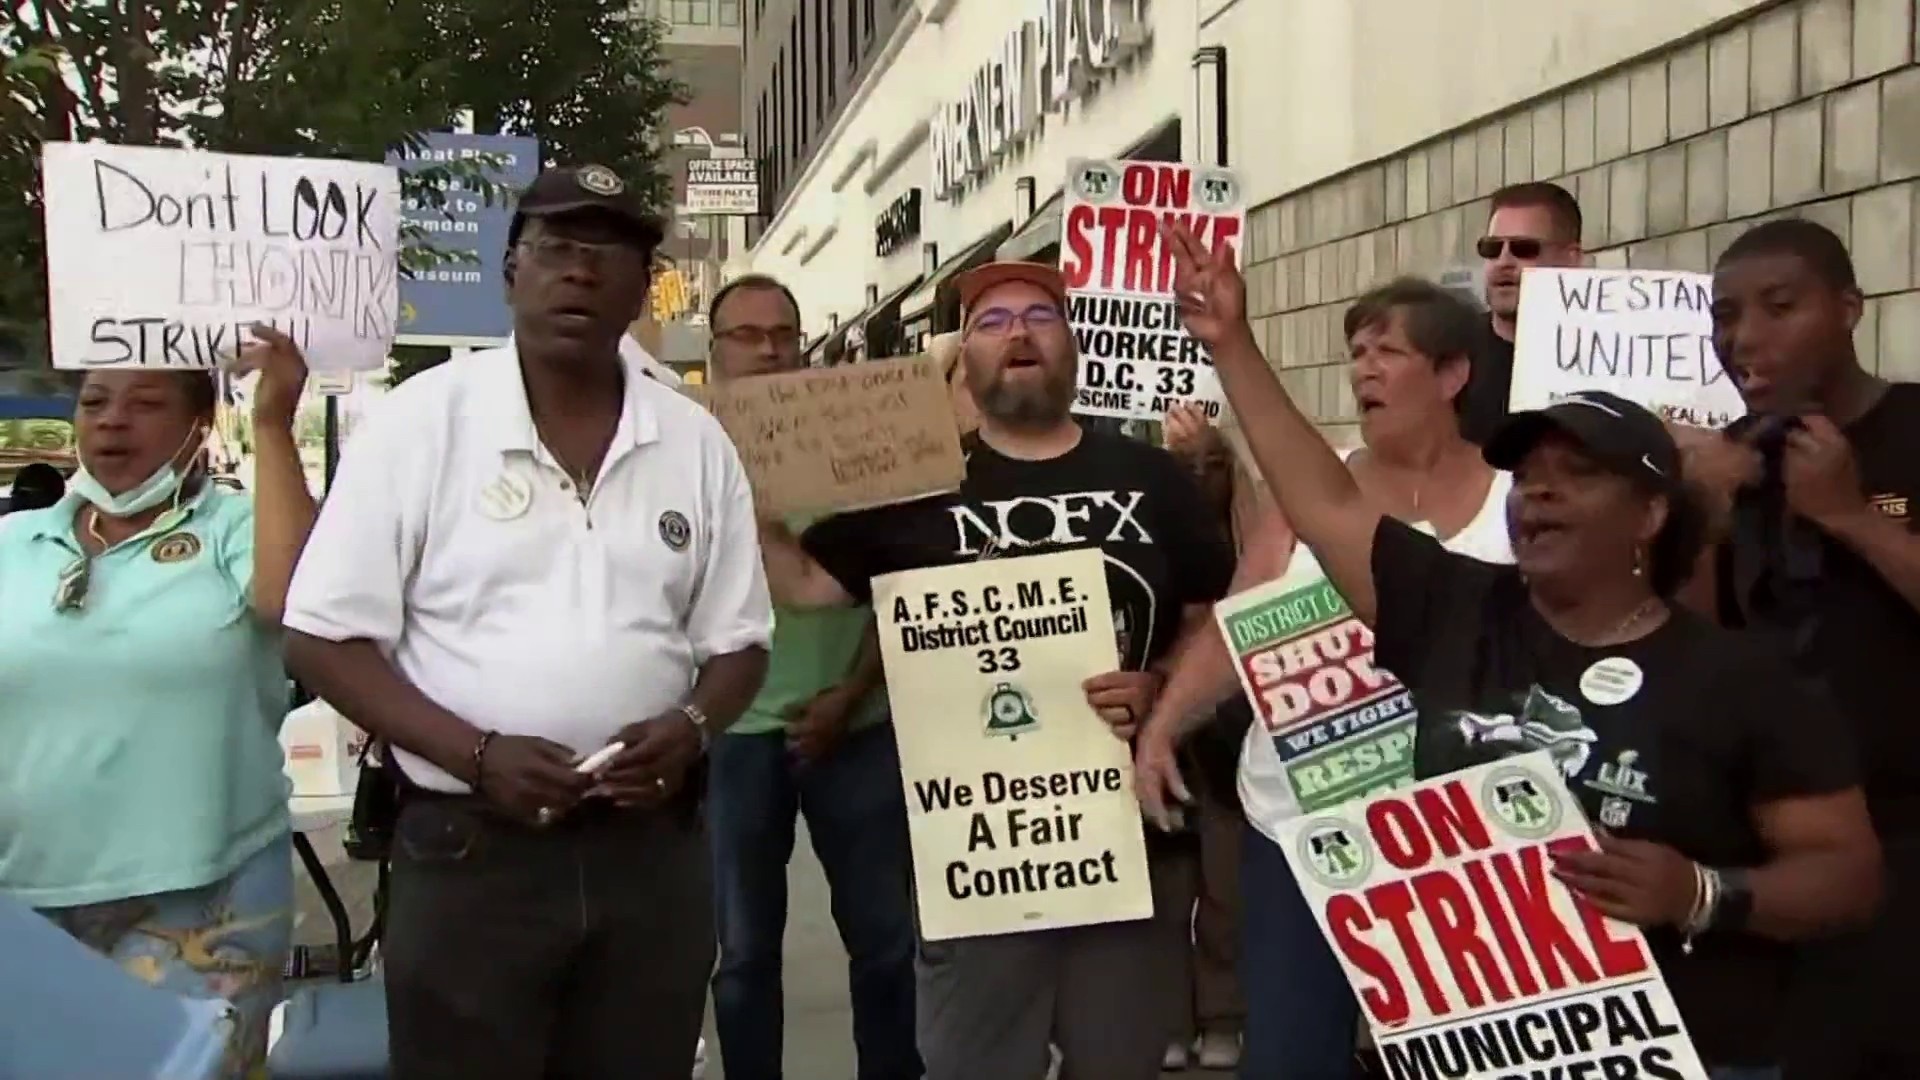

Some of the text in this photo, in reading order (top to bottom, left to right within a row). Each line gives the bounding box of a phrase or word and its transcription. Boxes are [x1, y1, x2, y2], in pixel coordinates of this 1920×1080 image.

[688, 171, 757, 182] AVAILABLE
[1122, 165, 1191, 209] ON
[93, 158, 382, 249] Don't LOOK
[179, 239, 398, 339] HONK
[1558, 273, 1618, 315] WE
[1086, 361, 1196, 395] D.C. 33
[949, 490, 1153, 555] NOFX
[893, 577, 1089, 624] A.F.S.C.M.E.
[1234, 595, 1320, 648] DISTRICT
[902, 606, 1088, 653] District Council
[977, 647, 1021, 674] 33
[1287, 724, 1329, 751] WE
[914, 767, 1121, 813] We Deserve
[968, 804, 1083, 852] A Fair
[1366, 780, 1491, 869] ON
[946, 849, 1118, 900] Contract
[1326, 835, 1648, 1027] STRIKE
[1382, 990, 1681, 1080] MUNICIPAL
